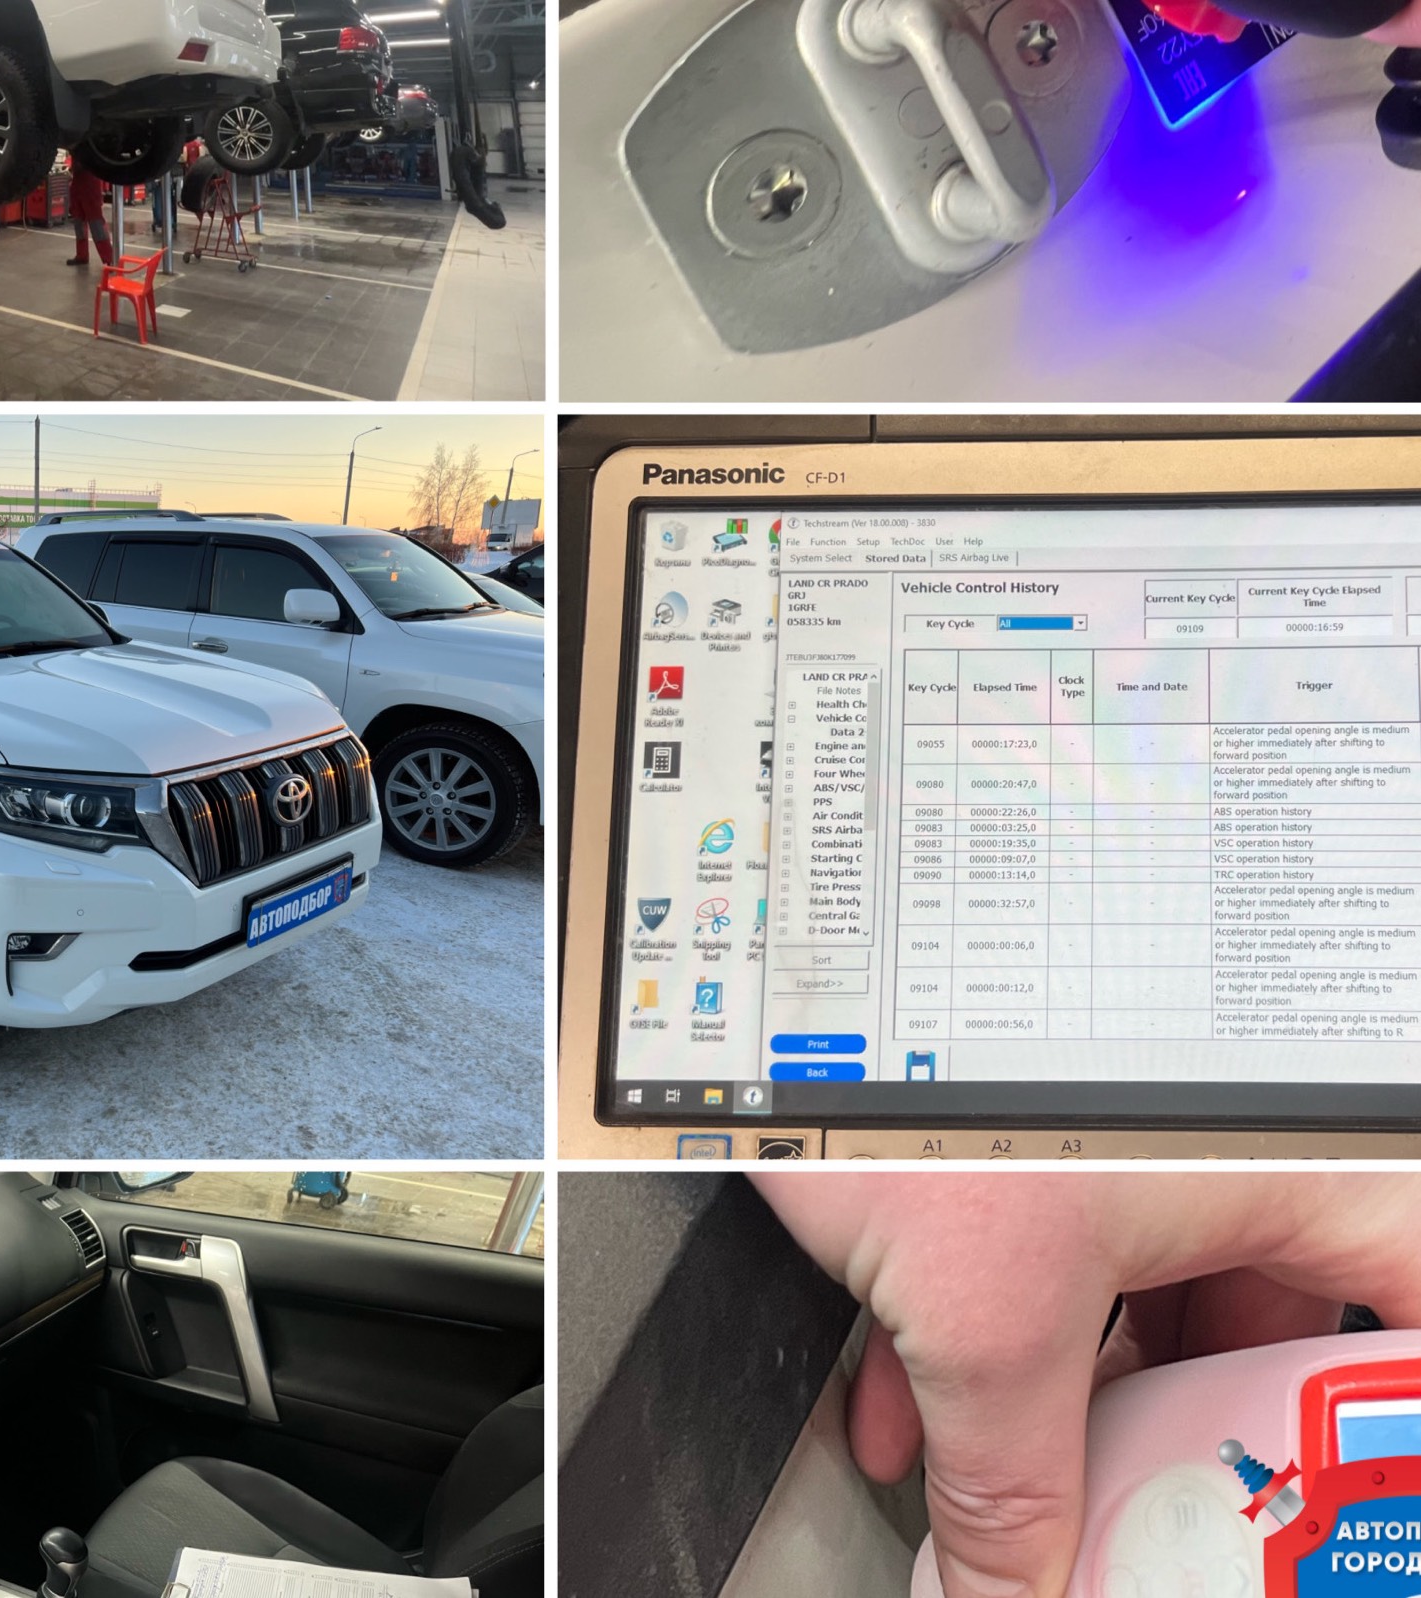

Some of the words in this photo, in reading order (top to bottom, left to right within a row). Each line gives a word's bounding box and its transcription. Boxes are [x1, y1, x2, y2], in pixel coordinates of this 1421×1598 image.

[643, 462, 785, 485] Panasonic
[806, 472, 845, 484] CF-D1
[804, 520, 848, 528] Techstream
[852, 520, 867, 528] (Ver
[870, 520, 908, 528] 18.00.008)
[917, 519, 935, 527] 3830
[811, 538, 846, 546] Function
[857, 538, 880, 547] Setup
[891, 538, 925, 546] TechDoc
[936, 538, 953, 546] User
[964, 538, 983, 547] Help
[790, 555, 822, 564] System
[826, 554, 852, 562] Select
[865, 555, 899, 563] Stored
[902, 555, 926, 563] Data
[939, 554, 957, 562] SRS
[961, 554, 989, 564] Airbag
[992, 554, 1008, 562] Live
[901, 583, 952, 593] Vehicle
[956, 583, 1006, 593] Control
[1011, 583, 1059, 595] History
[1248, 587, 1287, 596] Current
[1290, 587, 1309, 596] Key
[1312, 587, 1339, 596] Cycle
[1342, 586, 1381, 596] Elapsed
[1146, 594, 1183, 603] Current
[1187, 594, 1206, 604] Key
[1209, 594, 1235, 604] Cycle
[1303, 599, 1326, 608] Time
[787, 618, 824, 626] 058335
[827, 618, 841, 626] km
[927, 620, 946, 628] Key
[948, 620, 975, 628] Cycle
[1000, 620, 1011, 628] All
[1177, 624, 1204, 633] 09109
[1286, 623, 1343, 632] 00000:16:59
[803, 673, 829, 681] LAND
[832, 673, 845, 681] CR
[1059, 677, 1084, 685] Clock
[908, 684, 928, 693] Key
[930, 684, 956, 692] Cycle
[974, 683, 1011, 693] Elapsed
[1014, 683, 1037, 691] Time
[1117, 683, 1139, 691] Time
[1142, 683, 1160, 691] and
[1164, 683, 1188, 691] Date
[1296, 681, 1333, 691] Trigger
[1061, 689, 1085, 698] Type
[859, 728, 864, 736] 2
[1213, 726, 1264, 735] Accelerator
[1267, 726, 1292, 736] pedal
[1295, 726, 1330, 737] opening
[1334, 726, 1358, 736] angle
[1362, 726, 1370, 734] is
[1373, 726, 1410, 734] medium
[815, 742, 848, 752] Engine
[972, 740, 1037, 749] 00000:17:23,0
[1226, 739, 1255, 749] higher
[1257, 739, 1312, 748] immediately
[1315, 738, 1336, 747] after
[1340, 738, 1372, 748] shifting
[815, 756, 846, 764] Cruise
[1213, 751, 1249, 760] forward
[1252, 751, 1286, 761] position
[814, 770, 836, 778] Four
[971, 780, 1036, 789] 00000:20:47,0
[813, 798, 832, 806] PPS
[813, 812, 828, 820] Air
[971, 808, 1036, 817] 00000:22:26,0
[1214, 808, 1232, 816] ABS
[1235, 808, 1278, 817] operation
[1281, 808, 1312, 817] history
[915, 824, 942, 832] 09083
[970, 824, 1036, 832] 00000:03:25,0
[915, 840, 942, 848] 09083
[970, 840, 1036, 848] 00000:19:35,0
[1215, 839, 1233, 847] VSC
[1236, 839, 1279, 849] operation
[1283, 839, 1313, 849] history
[811, 855, 853, 864] Starting
[970, 856, 1036, 864] 00000:09:07,0
[969, 871, 1035, 880] 00000:13:14,0
[1215, 871, 1233, 879] TRC
[1237, 871, 1280, 880] operation
[1283, 871, 1314, 881] history
[913, 900, 941, 908] 09098
[968, 900, 1035, 909] 00000:32:57,0
[250, 885, 331, 940] АВТОПОДБОР
[643, 906, 667, 915] CUW
[912, 942, 939, 950] 09104
[967, 942, 1034, 950] 00000:00:06,0
[797, 980, 843, 988] Expand>>
[910, 984, 938, 992] 09104
[966, 984, 1034, 993] 00000:00:12,0
[966, 1020, 1033, 1029] 00000:00:56,0
[808, 1041, 829, 1049] Print
[923, 1140, 942, 1152] A1
[991, 1140, 1012, 1153] A2
[1061, 1140, 1082, 1153] A3
